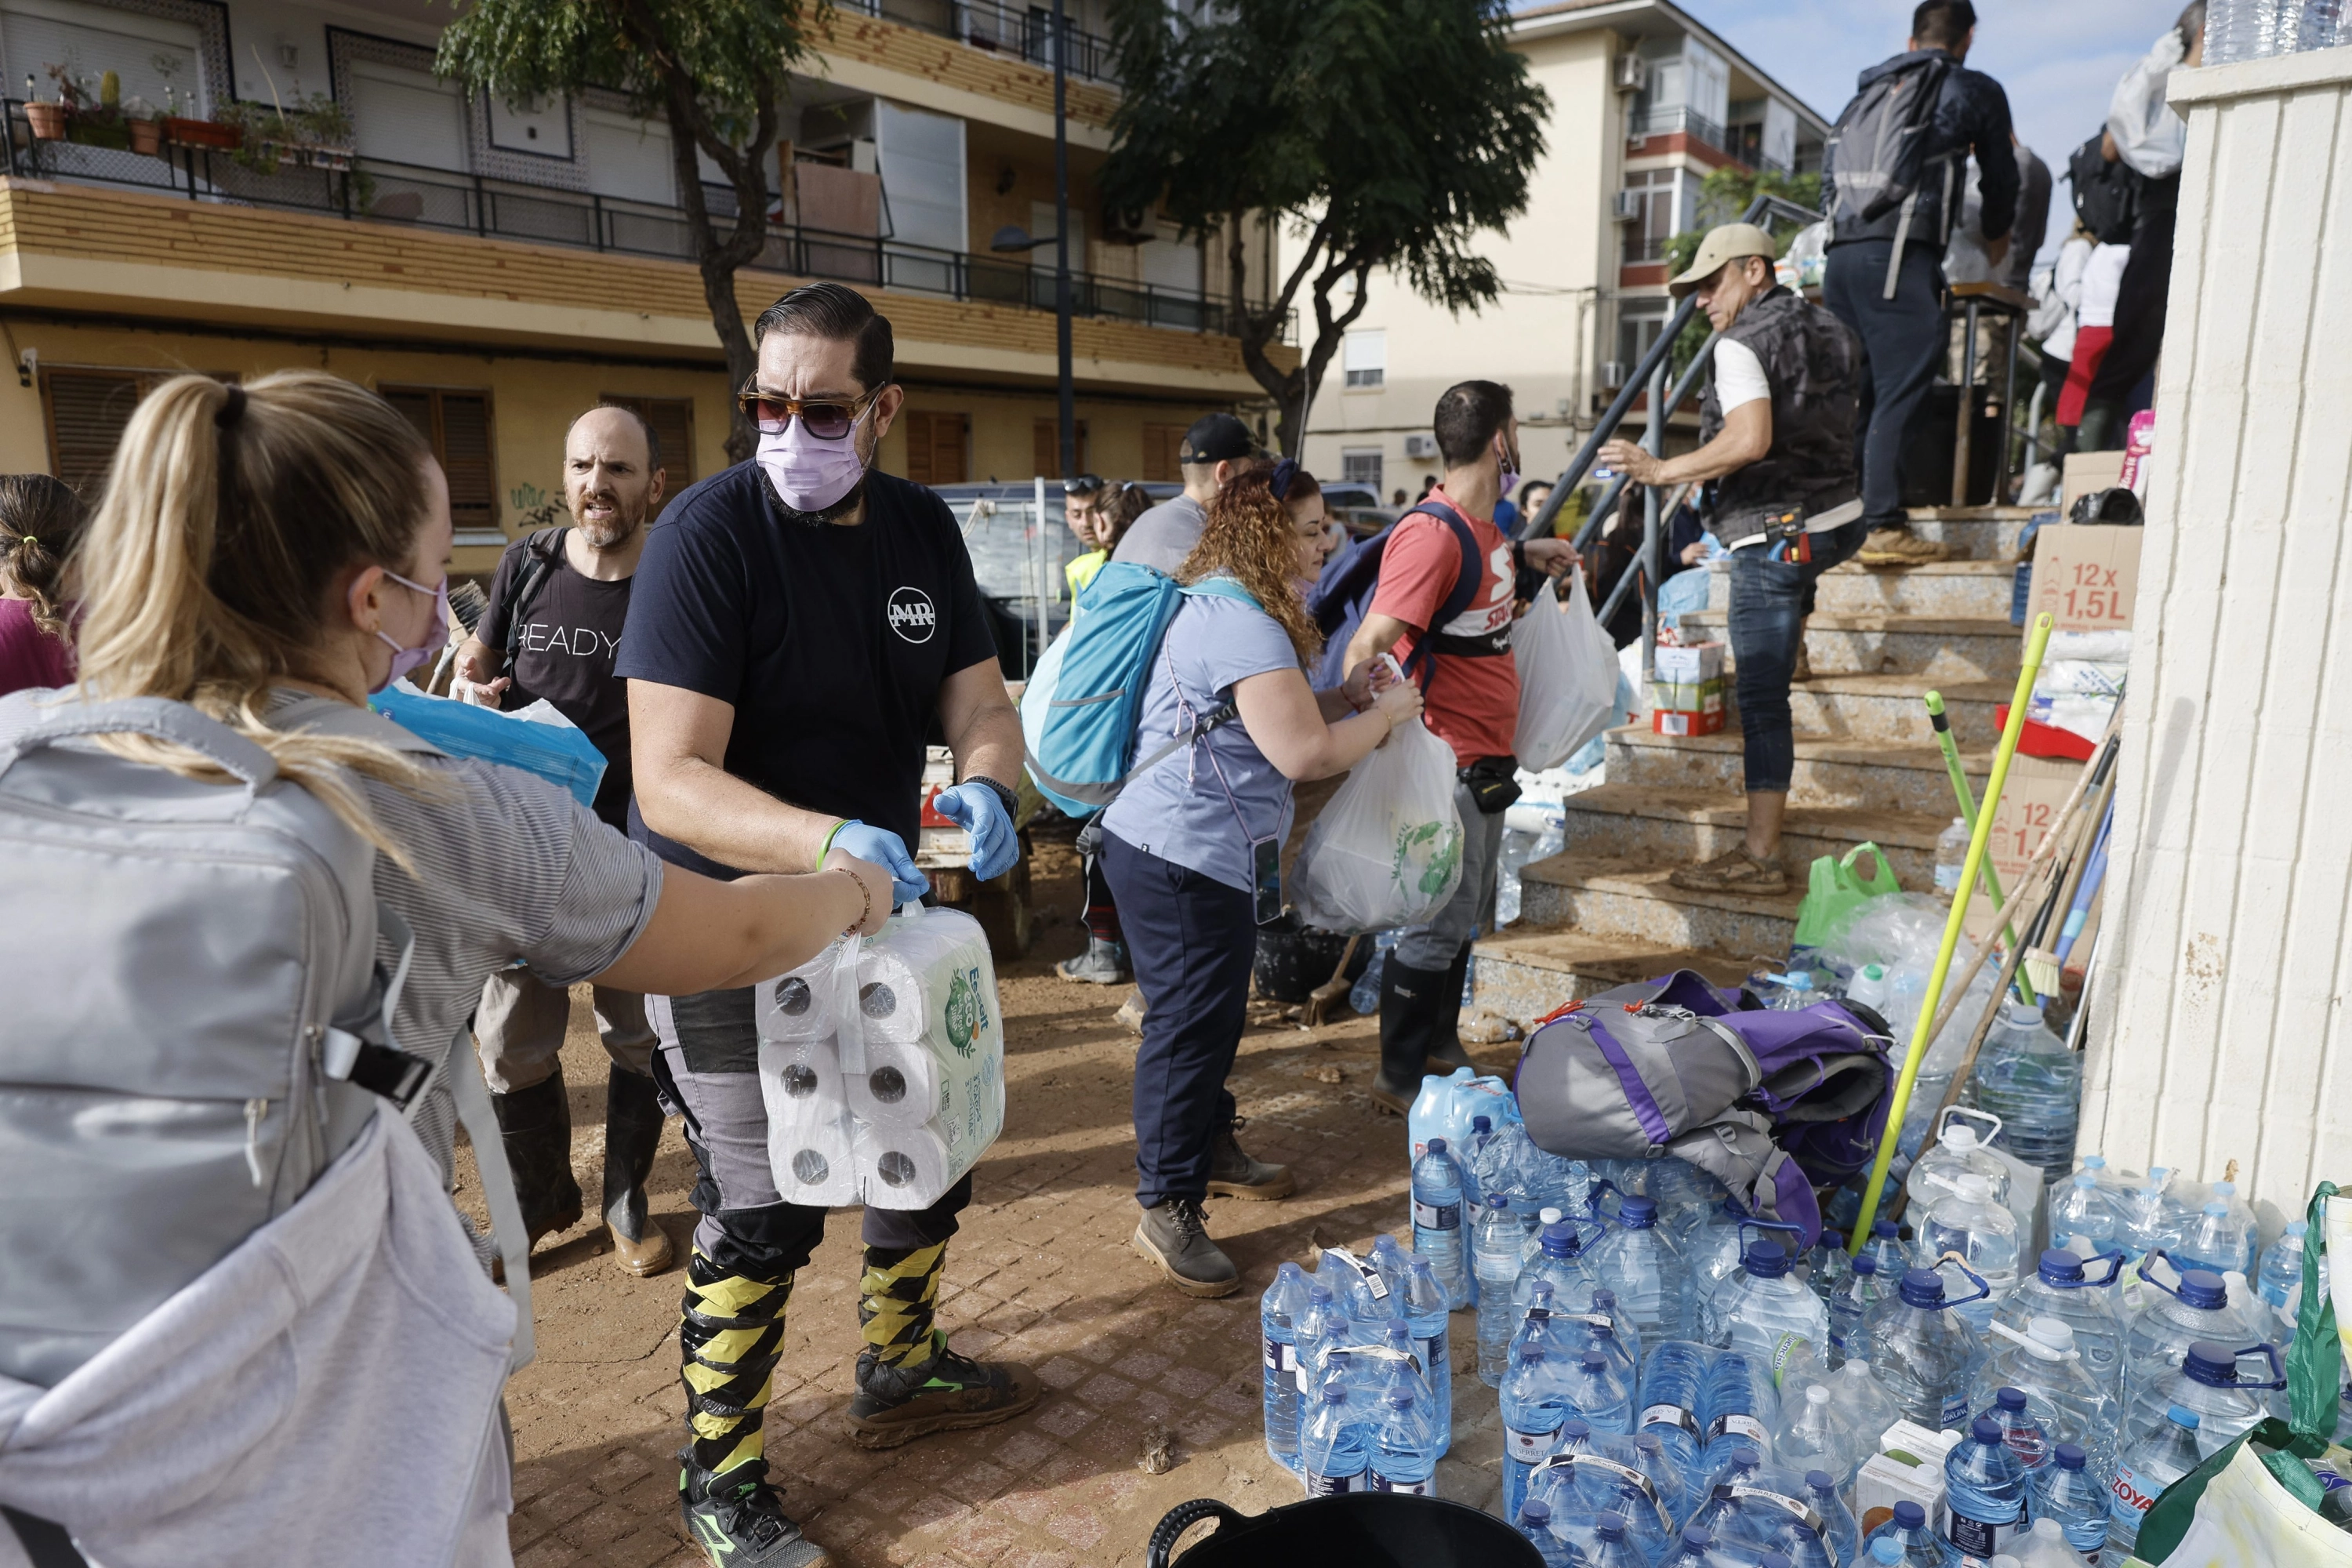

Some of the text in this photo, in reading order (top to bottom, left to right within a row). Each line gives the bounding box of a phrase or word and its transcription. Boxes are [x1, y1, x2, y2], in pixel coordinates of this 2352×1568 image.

[2074, 564, 2100, 586] 12
[891, 603, 934, 626] MR
[519, 624, 621, 659] READY
[2023, 803, 2050, 826] 12
[964, 991, 974, 1028] eco
[1517, 1447, 1546, 1457] SERRET
[1749, 1489, 1785, 1502] SERRETA
[2111, 1475, 2154, 1511] ZOYA
